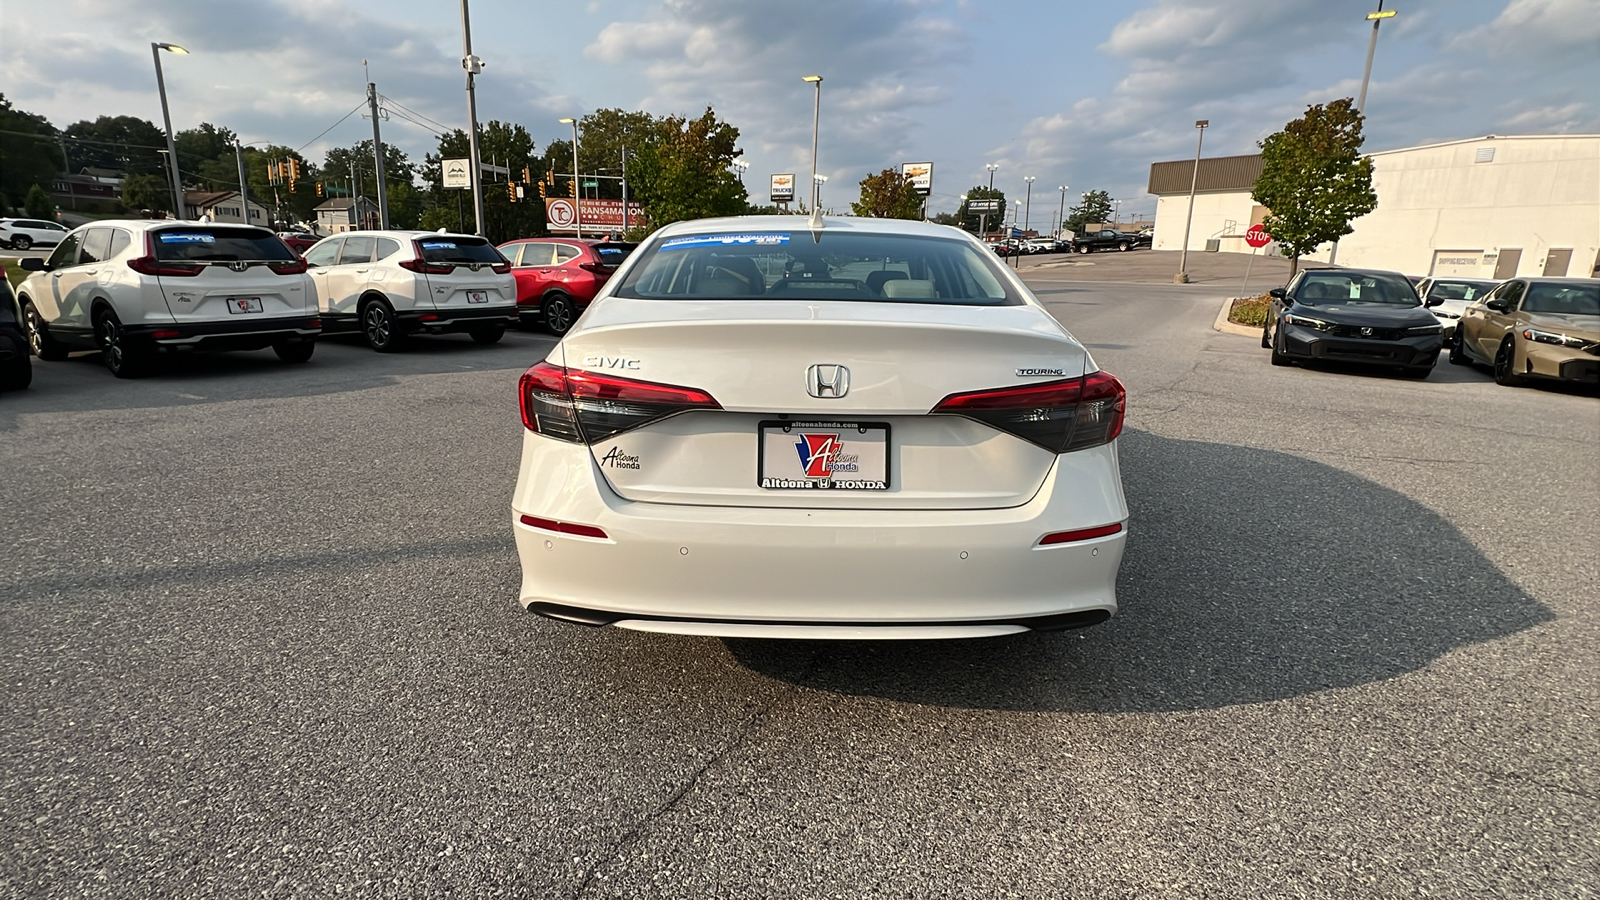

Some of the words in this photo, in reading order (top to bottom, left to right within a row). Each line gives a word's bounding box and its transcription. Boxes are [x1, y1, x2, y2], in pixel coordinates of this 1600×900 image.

[579, 206, 644, 215] RANS4MAION
[583, 357, 640, 370] CIVIC
[601, 445, 640, 468] Altoona
[806, 437, 858, 472] Altoona
[616, 461, 640, 470] Honda
[826, 461, 858, 471] Honda
[761, 478, 813, 488] Altoona
[834, 481, 886, 489] HONDA
